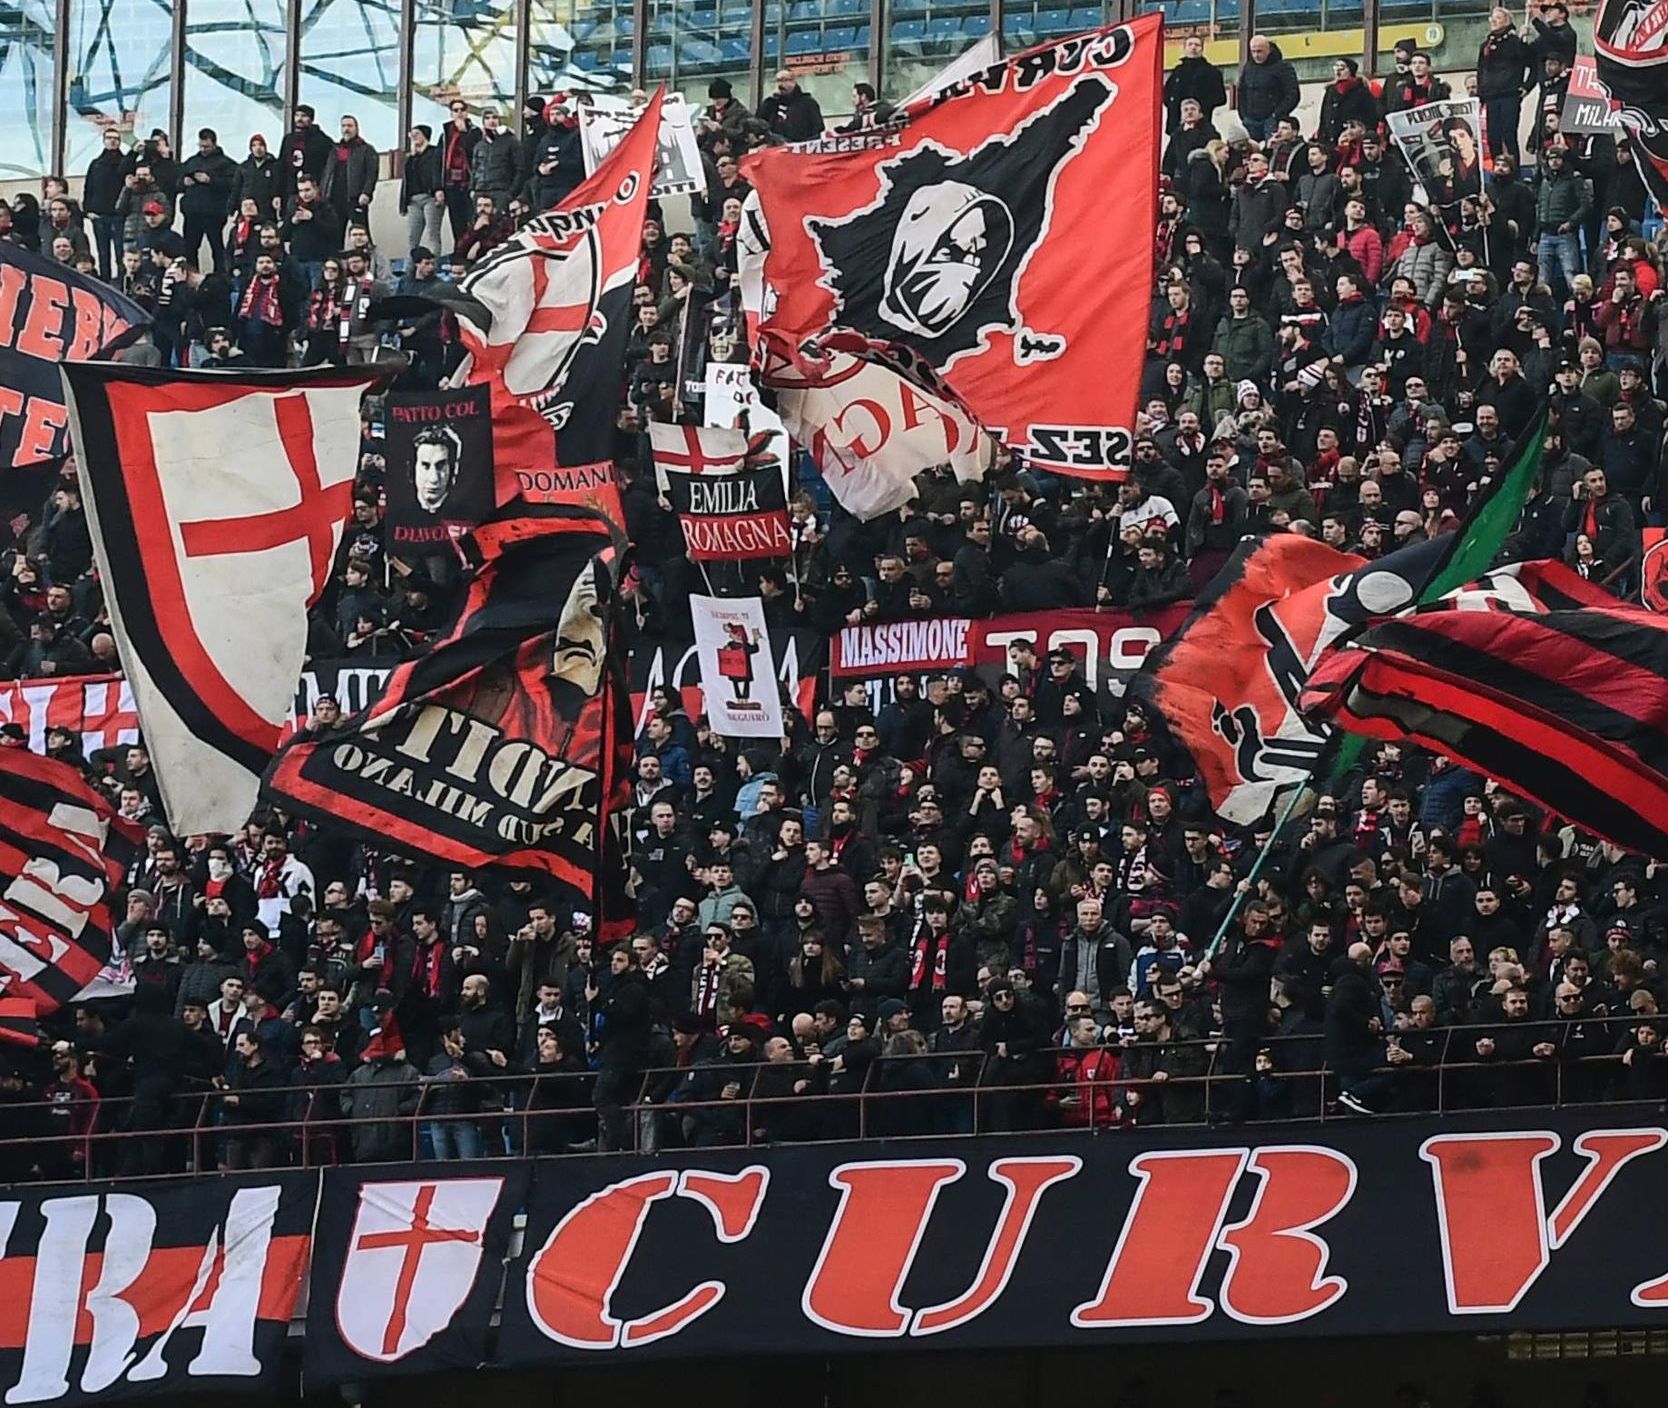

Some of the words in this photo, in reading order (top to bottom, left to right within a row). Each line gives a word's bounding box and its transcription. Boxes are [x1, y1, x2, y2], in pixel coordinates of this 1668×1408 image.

[517, 463, 616, 491] DOMANI
[690, 479, 759, 514] EMILIA
[681, 516, 791, 553] ROMAGNA
[840, 619, 971, 669] MASSIMONE
